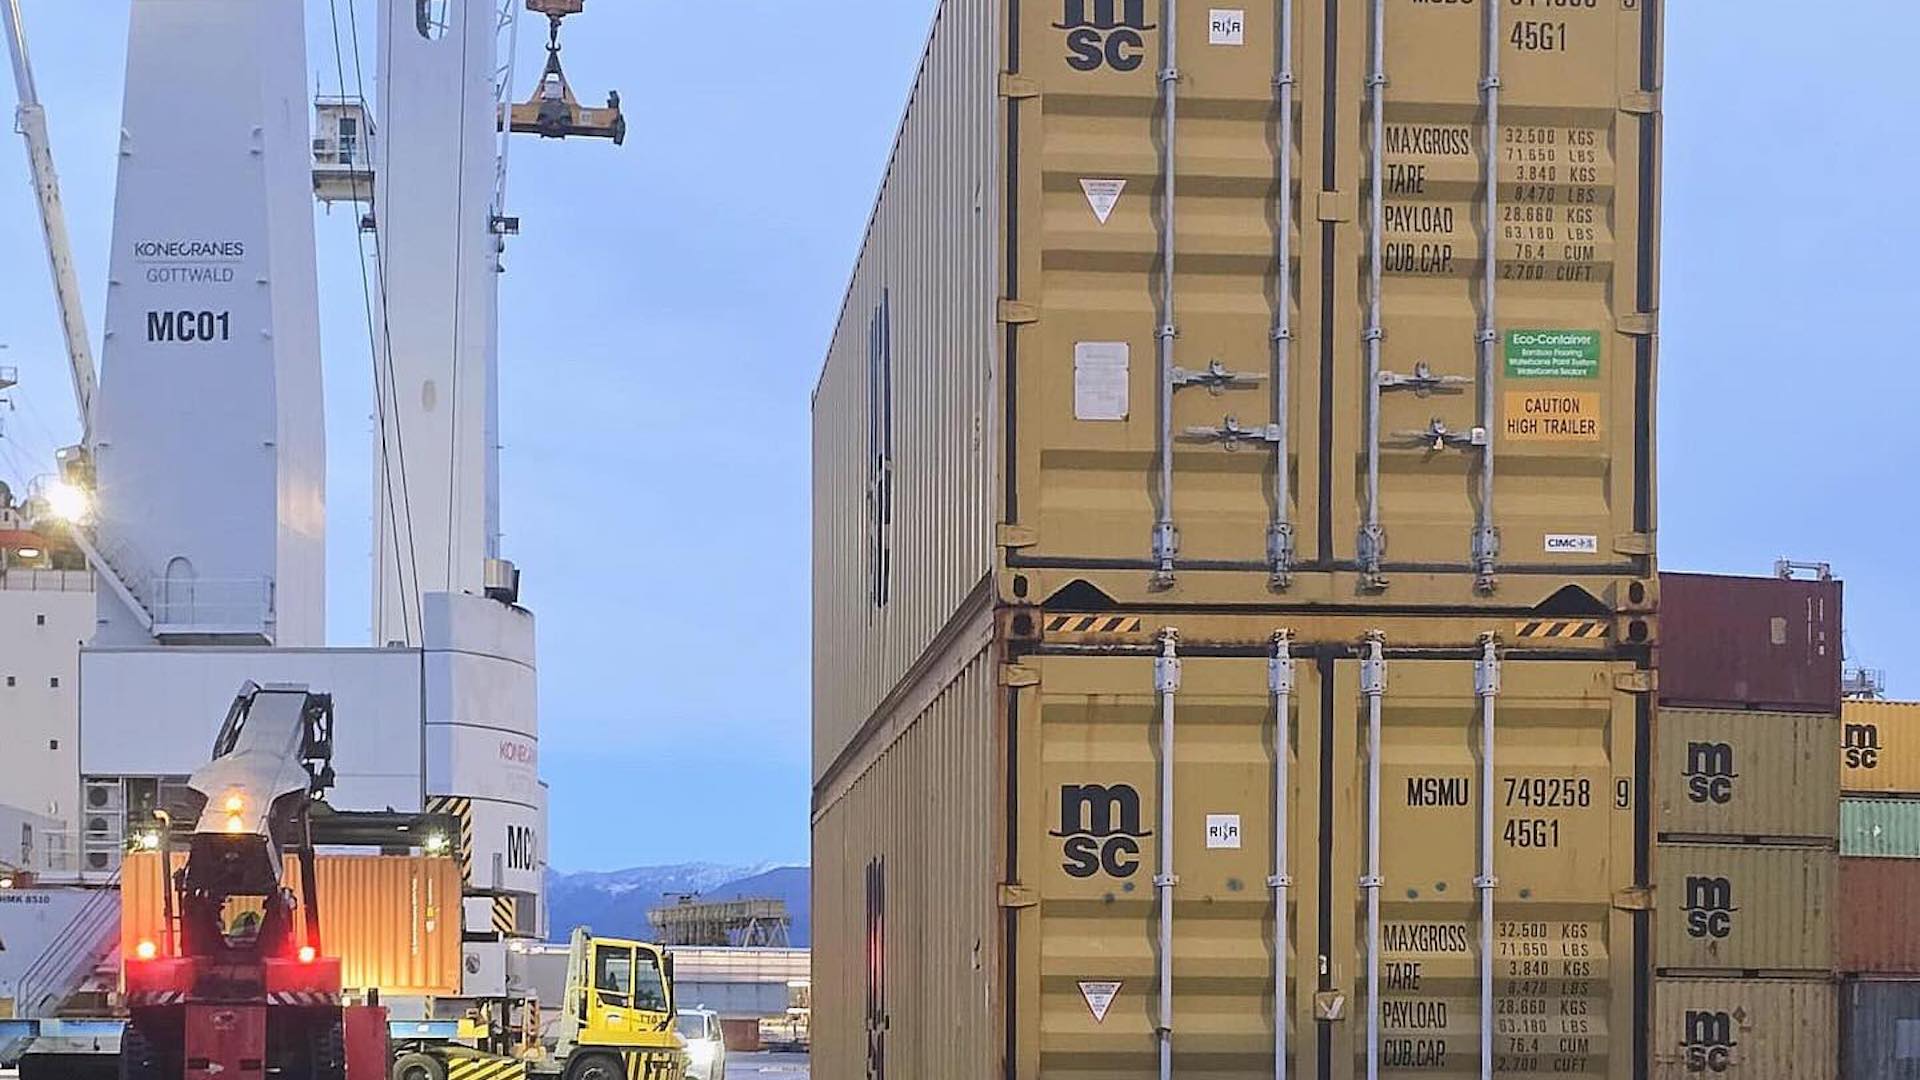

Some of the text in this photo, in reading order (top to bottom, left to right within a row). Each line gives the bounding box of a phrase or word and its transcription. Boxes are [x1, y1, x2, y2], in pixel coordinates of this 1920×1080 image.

[1510, 21, 1567, 51] 45G1
[1386, 127, 1470, 155] MAXGROSS
[1568, 129, 1595, 146] KGS
[1569, 150, 1595, 163] LBS
[1388, 164, 1425, 194] TARE
[1516, 165, 1596, 182] 3.840 KGS
[1567, 187, 1595, 203] LBS
[1385, 206, 1453, 233] PAYLOAD
[1567, 207, 1593, 224] KGS
[1567, 228, 1594, 240] LBS
[135, 242, 244, 256] KONECRANES
[1565, 245, 1594, 261] CUM
[146, 268, 234, 282] GOTTWALD
[1556, 266, 1593, 281] CUFT
[147, 311, 230, 341] MC01
[1525, 398, 1580, 413] CAUTION
[1507, 419, 1596, 434] HIGH TRAILER
[1548, 538, 1577, 548] CIMC
[1407, 778, 1629, 807] MSMU 749258 9
[1503, 819, 1559, 848] 45G1
[1384, 924, 1467, 952] MAXGROSS
[1562, 923, 1588, 939] KGS
[1562, 943, 1589, 957] LBS
[1386, 963, 1422, 990] TARE
[1509, 961, 1590, 976] 3.840 KGS
[1561, 982, 1588, 995] LBS
[1383, 1002, 1448, 1029] PAYLOAD
[1560, 1000, 1587, 1016] KGS
[1561, 1020, 1588, 1033] LBS
[1560, 1039, 1589, 1054] CUM
[1554, 1058, 1586, 1073] CUFT
